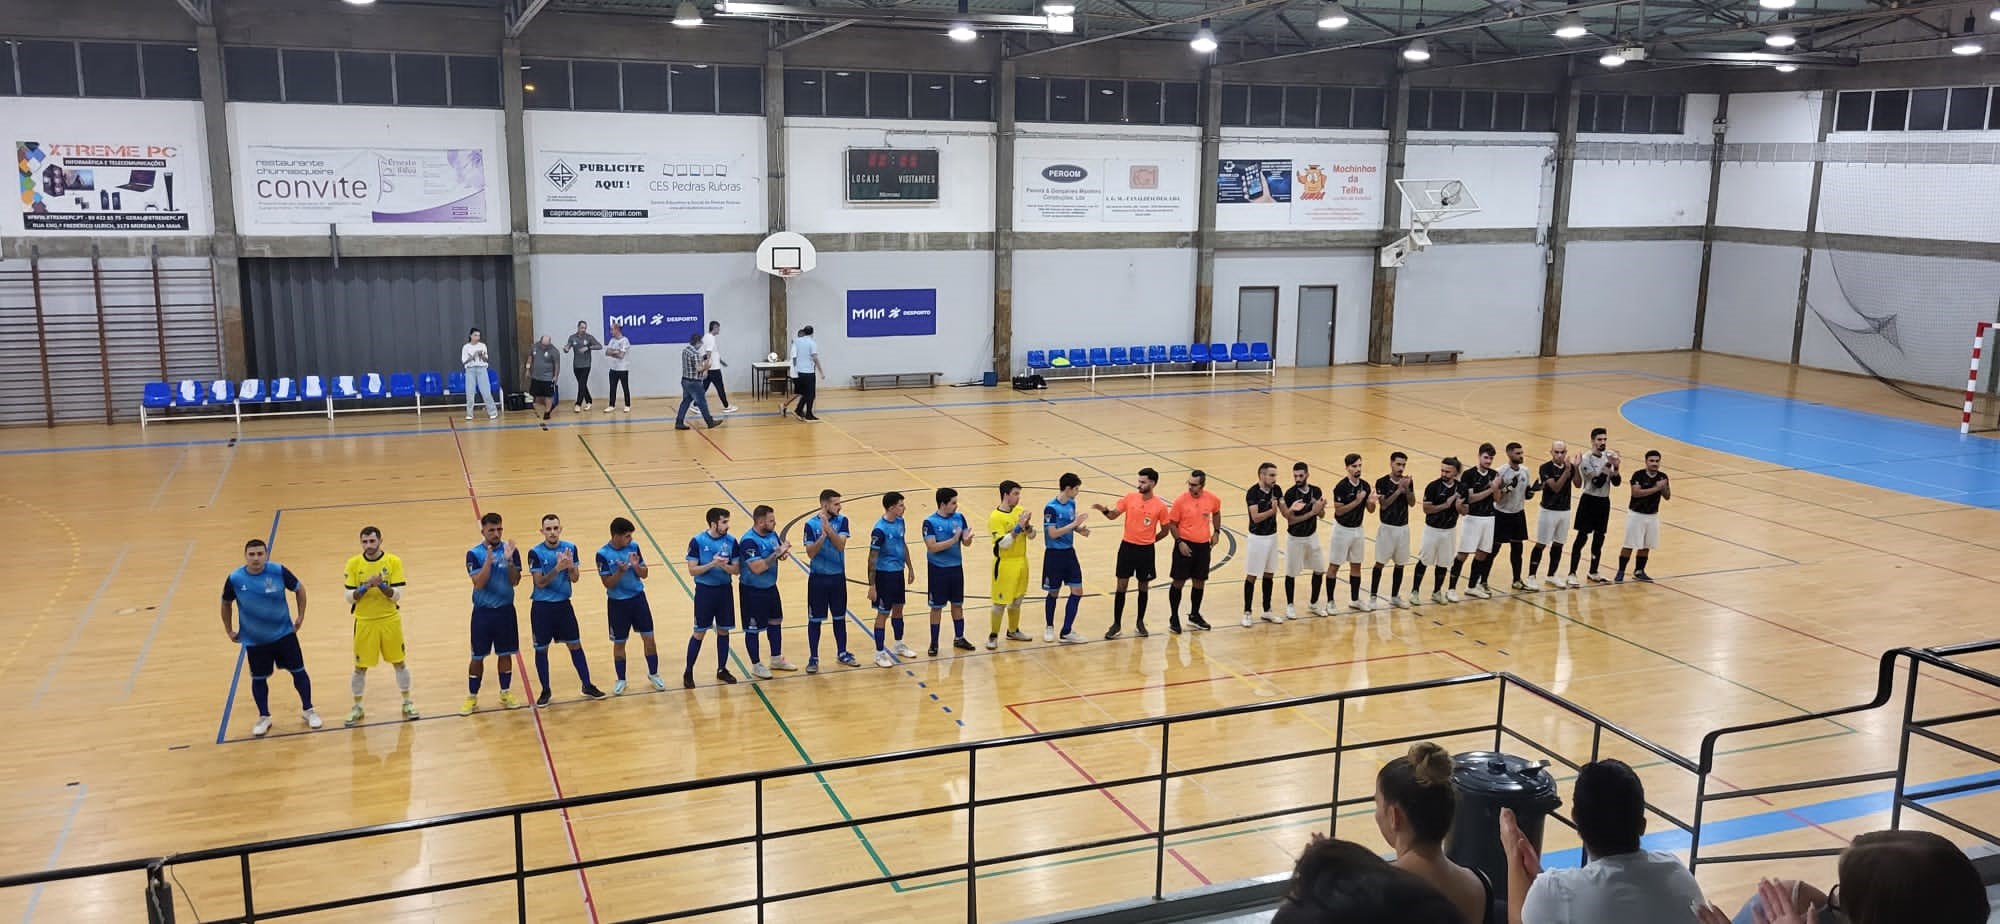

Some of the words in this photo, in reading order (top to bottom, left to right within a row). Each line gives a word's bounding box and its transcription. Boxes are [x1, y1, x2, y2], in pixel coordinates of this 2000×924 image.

[49, 143, 140, 157] XTREME
[147, 145, 177, 158] PC
[256, 168, 334, 176] churrasqueira
[579, 163, 645, 173] PUBLICITE
[1332, 164, 1377, 173] Mochinhas
[851, 174, 880, 183] LOCAIS
[898, 175, 936, 184] VISITANTES
[1048, 170, 1081, 178] PERGOM
[1347, 175, 1359, 183] da
[257, 177, 368, 199] convite
[595, 180, 624, 190] AQUI
[649, 180, 669, 191] CES
[672, 181, 706, 192] Pedras
[708, 181, 742, 192] Rubras
